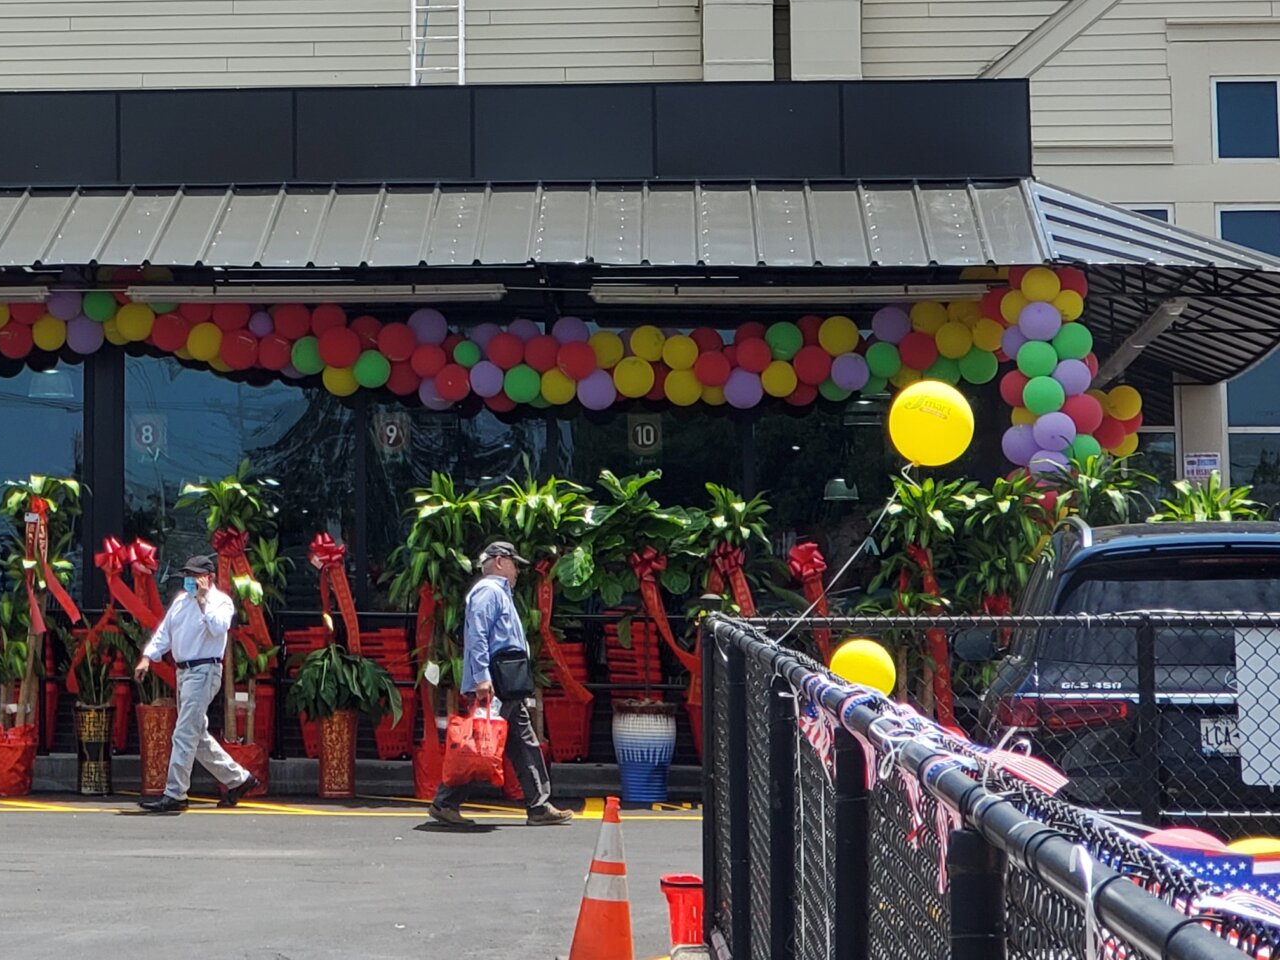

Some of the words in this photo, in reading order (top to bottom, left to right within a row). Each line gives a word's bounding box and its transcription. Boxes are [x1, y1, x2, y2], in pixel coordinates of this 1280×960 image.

[141, 424, 153, 444] 8
[386, 424, 397, 444] 9
[634, 425, 655, 446] 10
[1060, 681, 1090, 689] GLS
[1092, 681, 1122, 689] 450
